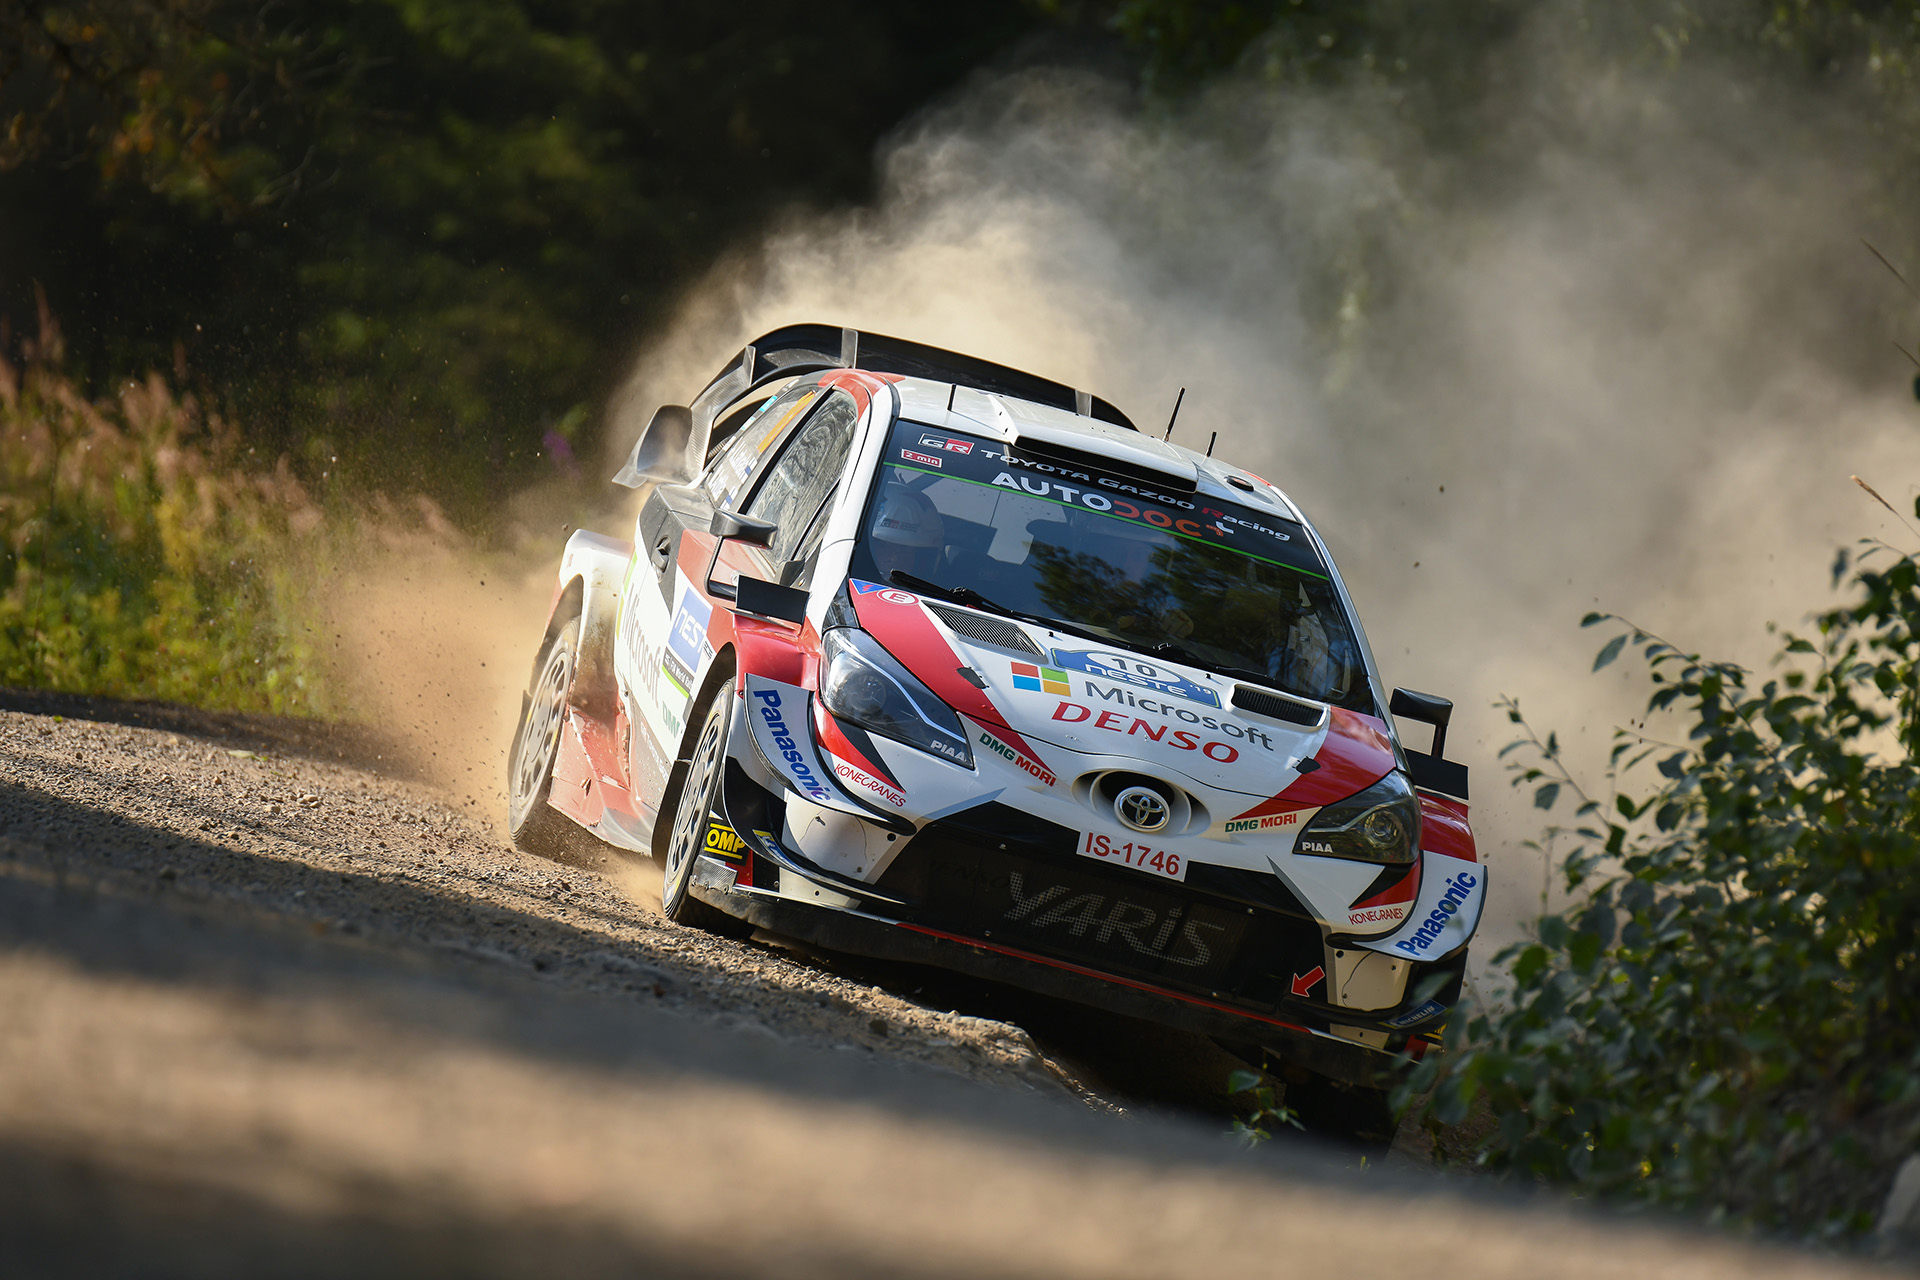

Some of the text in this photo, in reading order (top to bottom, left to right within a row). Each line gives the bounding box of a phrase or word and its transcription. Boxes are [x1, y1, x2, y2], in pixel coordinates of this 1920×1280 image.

[905, 451, 939, 466] 2 min
[920, 438, 969, 453] GR
[980, 449, 1291, 541] TOYOTA GAZOO Racing
[622, 583, 662, 709] Microsoft
[1111, 657, 1158, 678] 10
[1051, 701, 1240, 764] DENSO
[1085, 681, 1275, 752] Microsoft
[753, 689, 831, 802] Panasonic
[930, 740, 967, 762] PIAA
[978, 732, 1057, 787] DMG MORI
[834, 763, 907, 808] KONECRANES
[706, 829, 746, 853] OMP
[1224, 813, 1298, 833] DMG MORI
[1085, 832, 1181, 877] IS-1746
[1302, 841, 1334, 854] PIAA
[1348, 907, 1404, 925] KONECRANES
[1395, 871, 1477, 956] Panasonic
